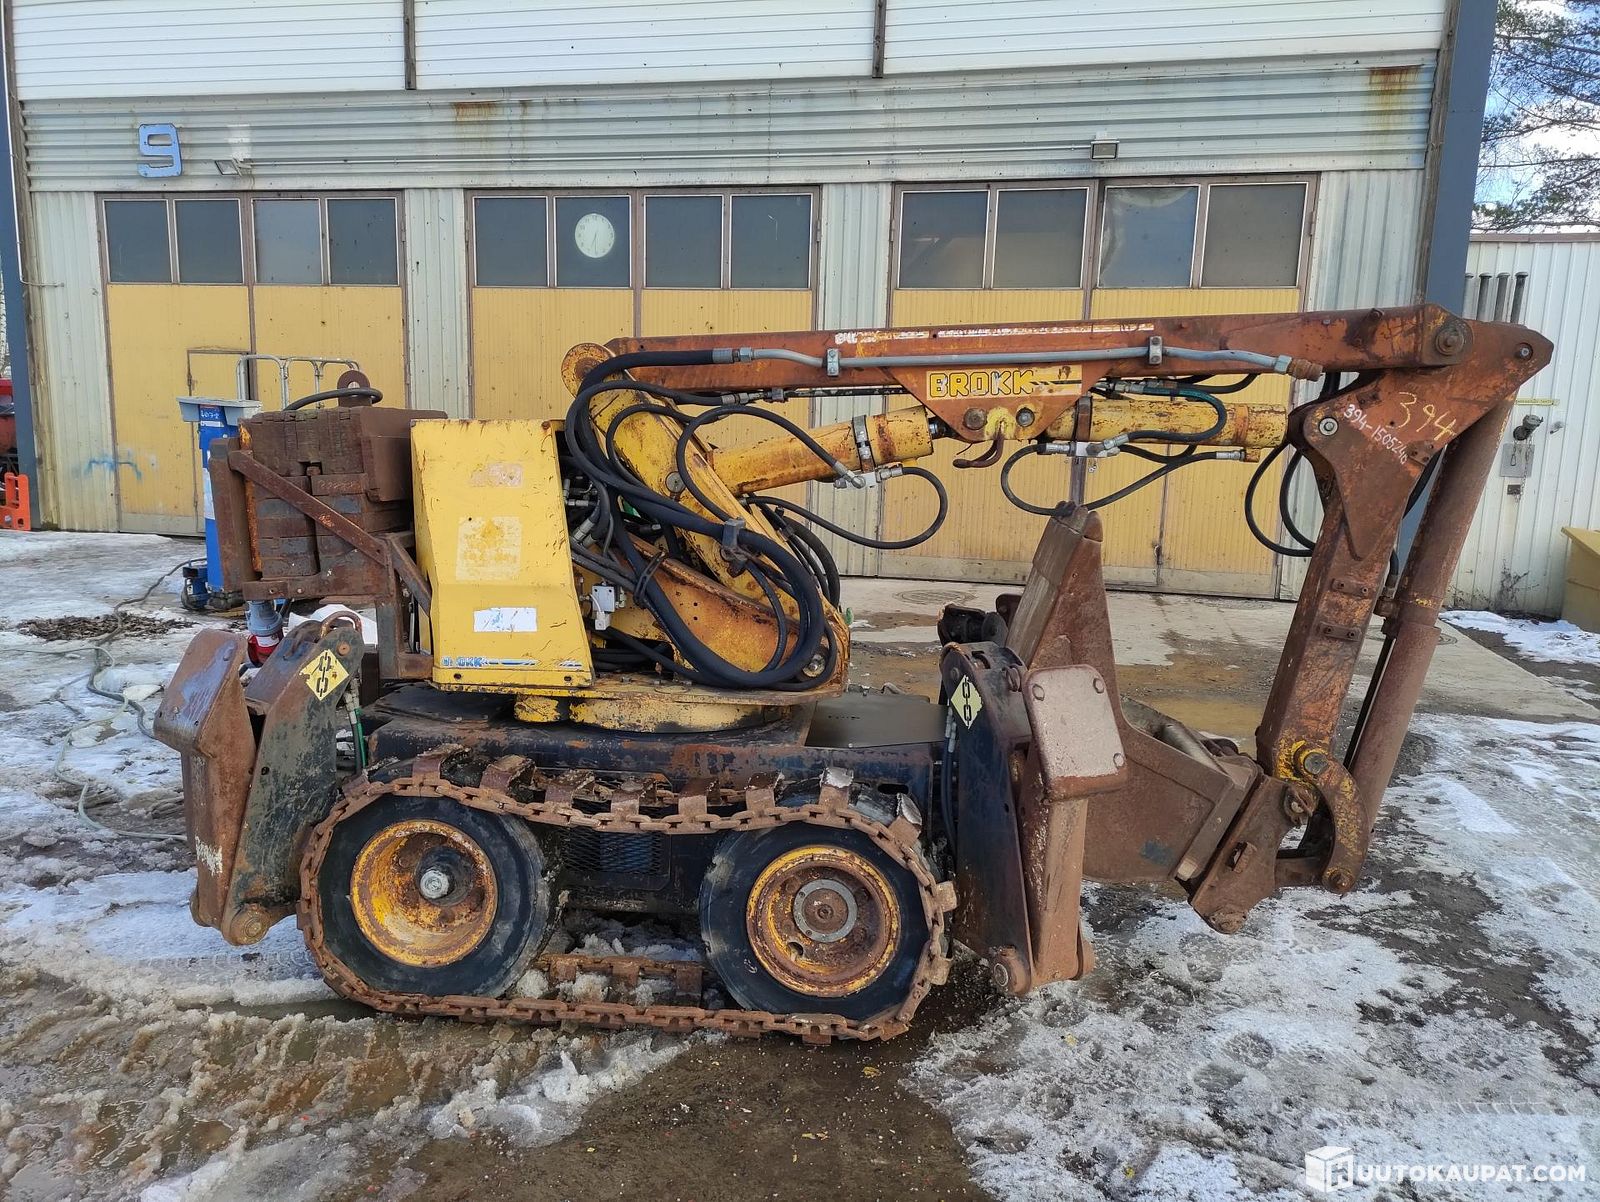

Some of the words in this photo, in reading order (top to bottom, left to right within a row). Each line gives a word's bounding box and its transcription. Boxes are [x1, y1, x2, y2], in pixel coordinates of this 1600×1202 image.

[138, 123, 182, 178] 9
[929, 369, 1034, 398] BROKK
[1384, 391, 1457, 441] 394
